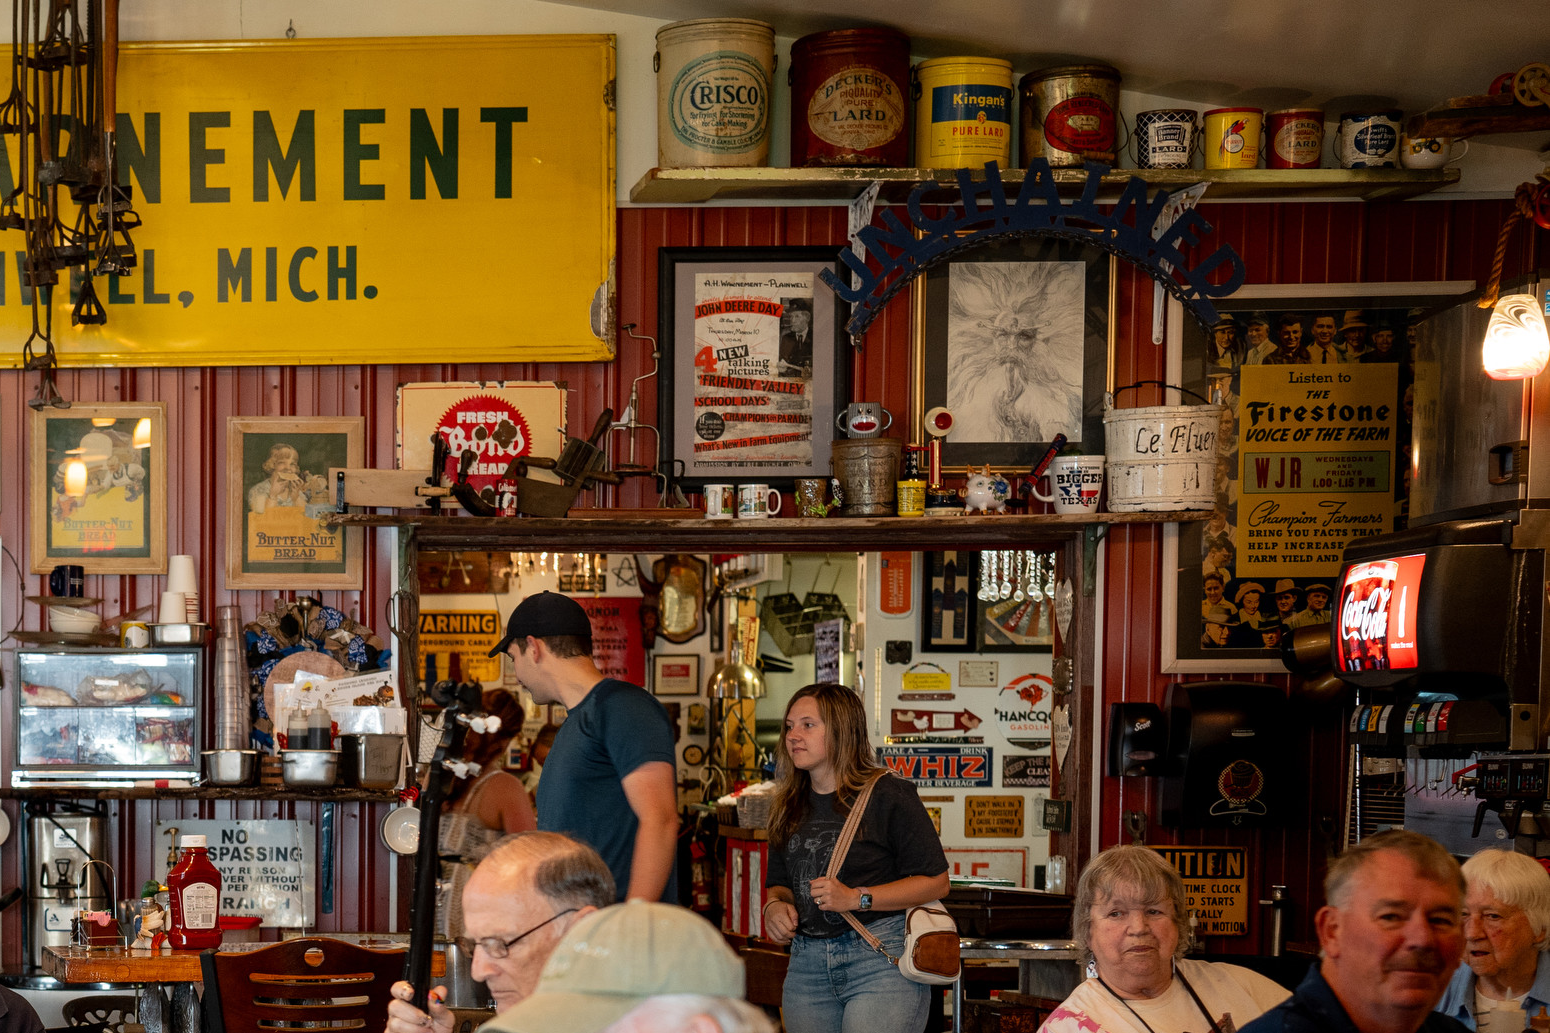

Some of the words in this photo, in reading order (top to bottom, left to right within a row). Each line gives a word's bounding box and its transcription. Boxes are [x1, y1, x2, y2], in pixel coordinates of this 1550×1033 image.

[825, 74, 892, 99] DECKER'S
[690, 80, 759, 111] CRISCO
[953, 93, 1005, 107] Kingan's
[833, 109, 886, 122] LARD
[952, 126, 980, 136] PURE
[983, 126, 1004, 137] LARD
[820, 157, 1246, 302] UNCHAINED
[216, 244, 380, 303] MICH.
[769, 278, 808, 289] PLAINWELL
[696, 302, 722, 318] JOHN
[724, 300, 756, 313] DEERE
[758, 302, 781, 317] DAY
[695, 346, 718, 374] 4
[719, 347, 748, 360] NEW
[727, 357, 770, 369] talking
[727, 366, 770, 377] pictures
[1288, 371, 1335, 385] Listen
[1337, 372, 1352, 384] to
[1305, 390, 1331, 400] THE
[457, 411, 509, 424] FRESH
[1245, 400, 1391, 428] Firestone
[1136, 427, 1162, 455] Le
[1245, 427, 1289, 443] VOICE
[1292, 427, 1312, 442] OF
[1317, 427, 1345, 442] THE
[1348, 426, 1390, 442] FARM
[722, 440, 738, 450] New
[740, 439, 747, 447] in
[749, 437, 767, 446] Farm
[1358, 477, 1376, 488] PM
[1060, 497, 1098, 506] TEXAS
[1247, 500, 1318, 529] Champion
[1318, 501, 1383, 527] Farmers
[1247, 528, 1284, 538] BRING
[1286, 528, 1310, 538] YOU
[1313, 528, 1349, 537] FACTS
[1351, 527, 1384, 537] THAT
[1247, 541, 1279, 550] HELP
[1283, 541, 1345, 550] INCREASE
[273, 547, 317, 559] BREAD
[1247, 554, 1278, 563] FARM
[1281, 554, 1314, 563] YIELD
[1318, 554, 1340, 563] AND
[881, 747, 907, 755] TAKE
[908, 747, 915, 755] A
[960, 747, 988, 755] DRINK
[884, 755, 985, 779] WHIZ
[1004, 760, 1027, 778] KEEP
[1026, 758, 1044, 766] THE
[221, 829, 249, 845] NO
[1184, 884, 1206, 893] TIME
[1211, 884, 1241, 893] CLOCK
[222, 897, 290, 910] RANCH
[1200, 897, 1235, 906] STARTS
[1212, 921, 1246, 932] MOTION
